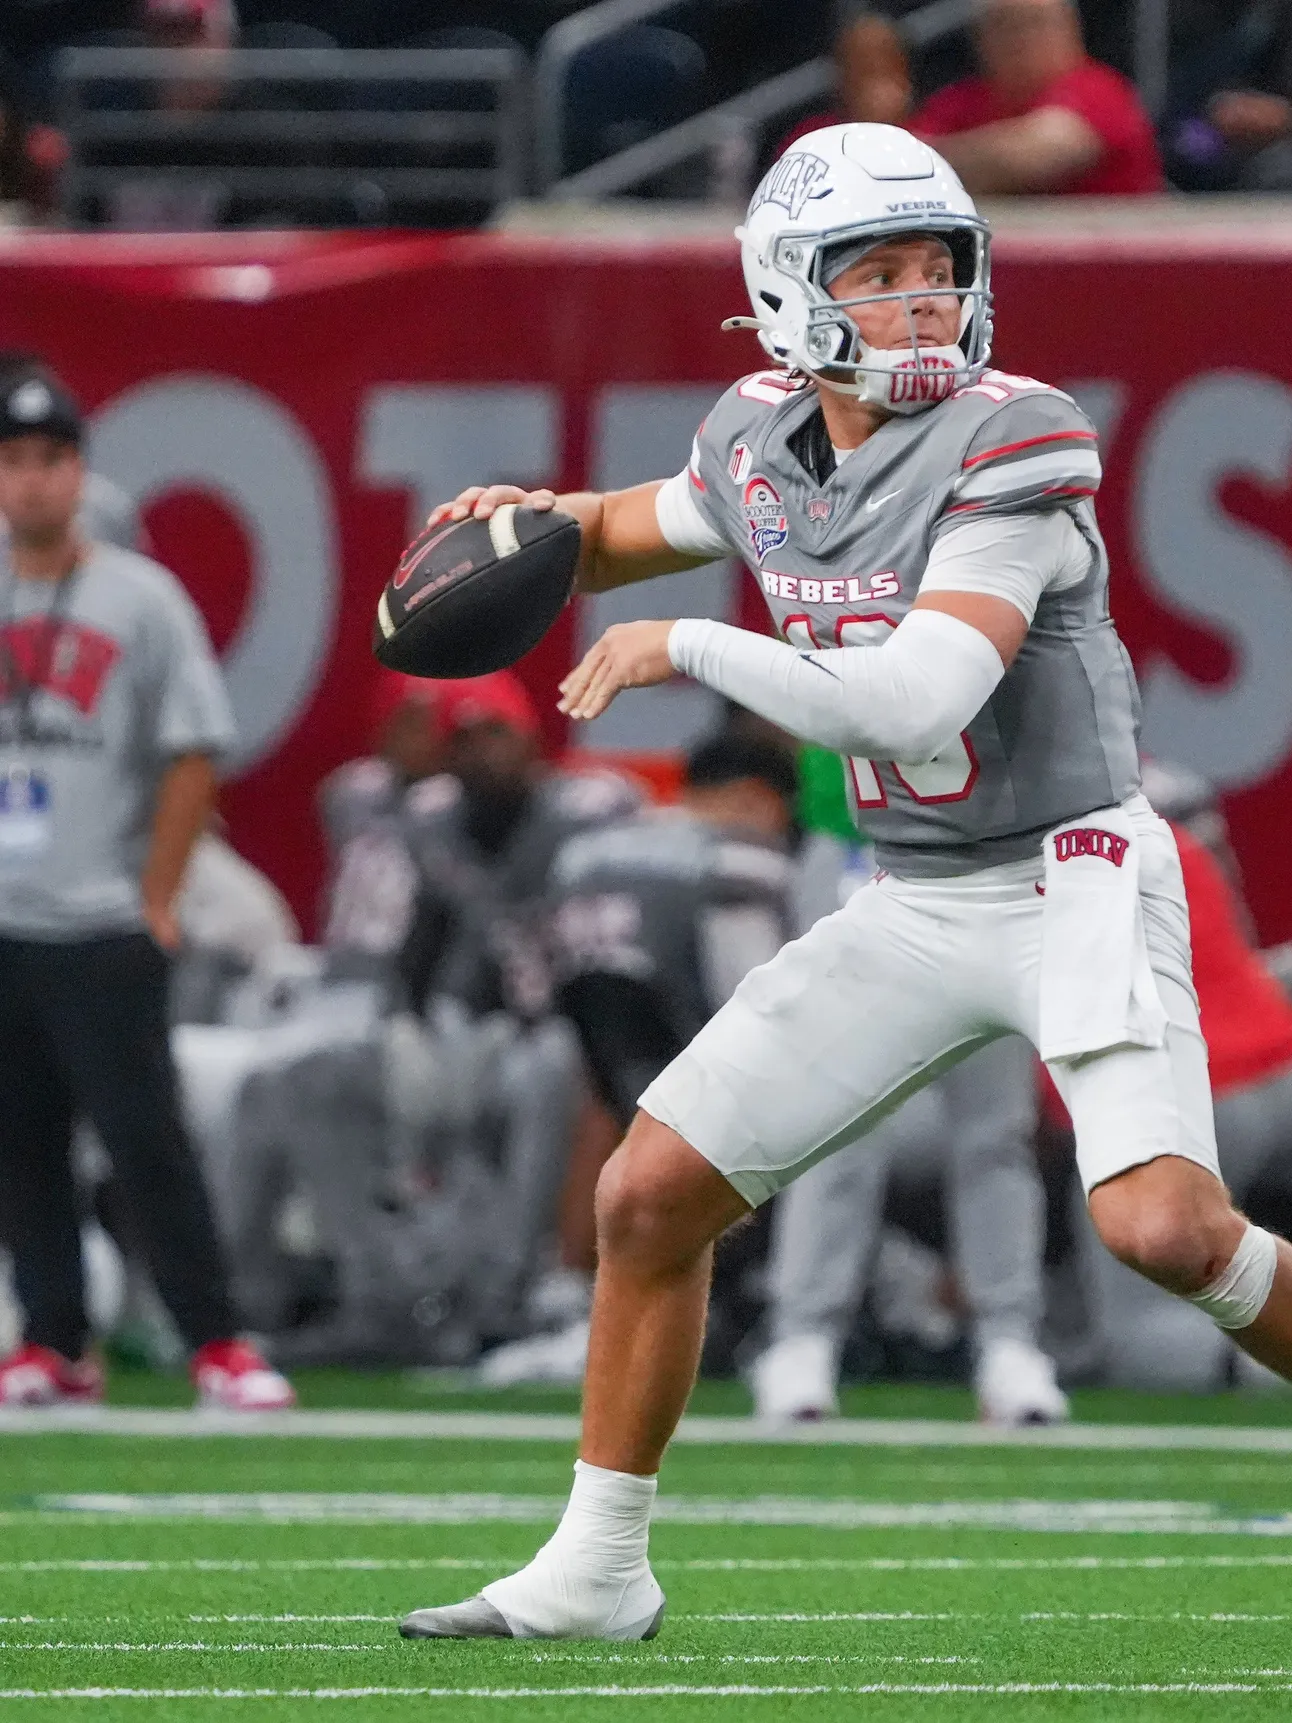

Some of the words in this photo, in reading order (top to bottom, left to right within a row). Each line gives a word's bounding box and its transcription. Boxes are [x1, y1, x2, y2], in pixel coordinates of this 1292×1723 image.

[885, 201, 947, 213] VEGAS
[761, 570, 900, 604] REBELS
[1053, 828, 1130, 868] UNLV
